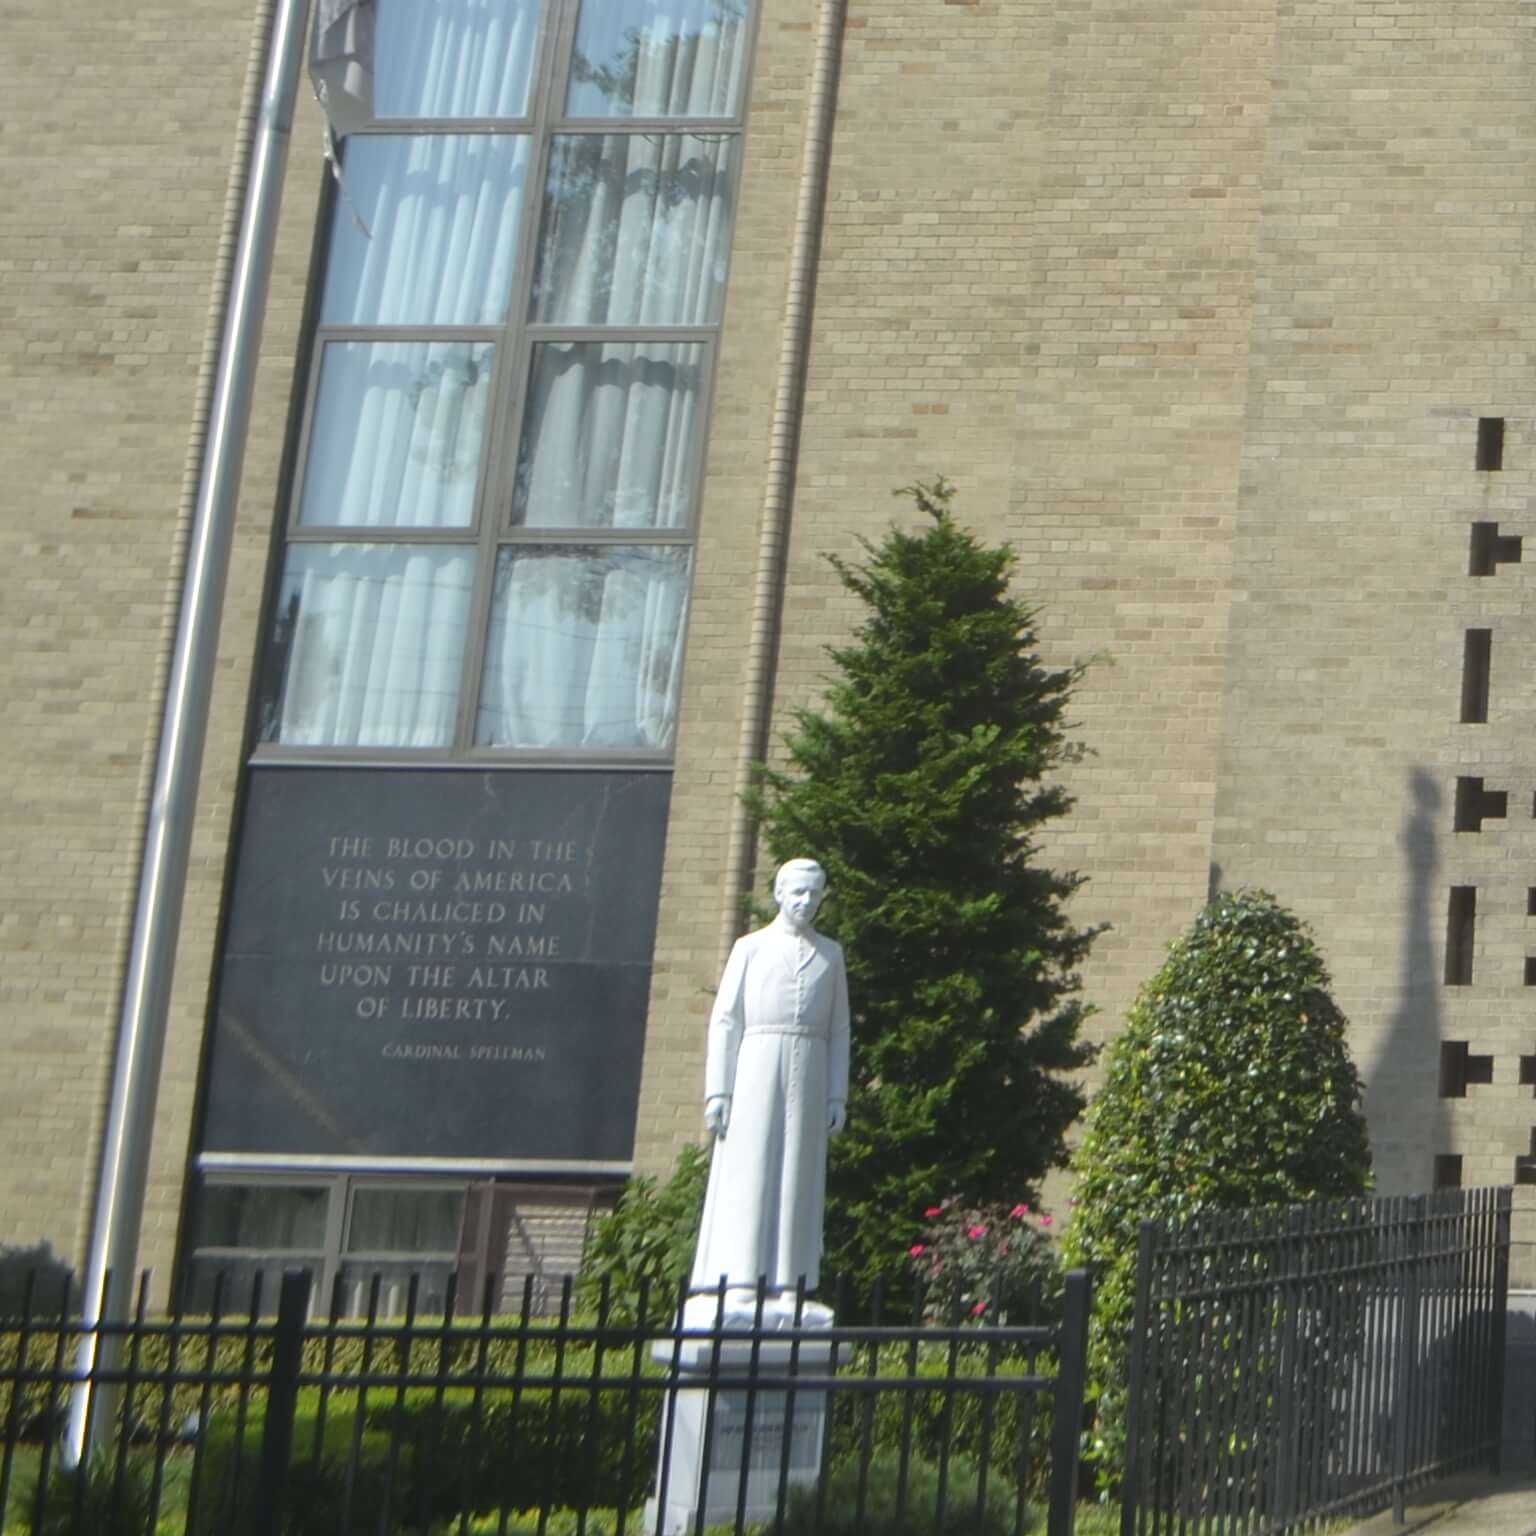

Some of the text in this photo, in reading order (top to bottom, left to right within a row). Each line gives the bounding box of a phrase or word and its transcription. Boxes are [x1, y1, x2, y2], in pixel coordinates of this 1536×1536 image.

[329, 835, 577, 861] THE BLOOD IN THE
[321, 867, 573, 893] VEINS OF AMERICA
[339, 899, 545, 924] IS CHALICED IN
[317, 930, 560, 956] HUMANITY'S NAME
[320, 964, 551, 989] UPON THE ALTAR
[356, 996, 511, 1021] OF LIBERTY.
